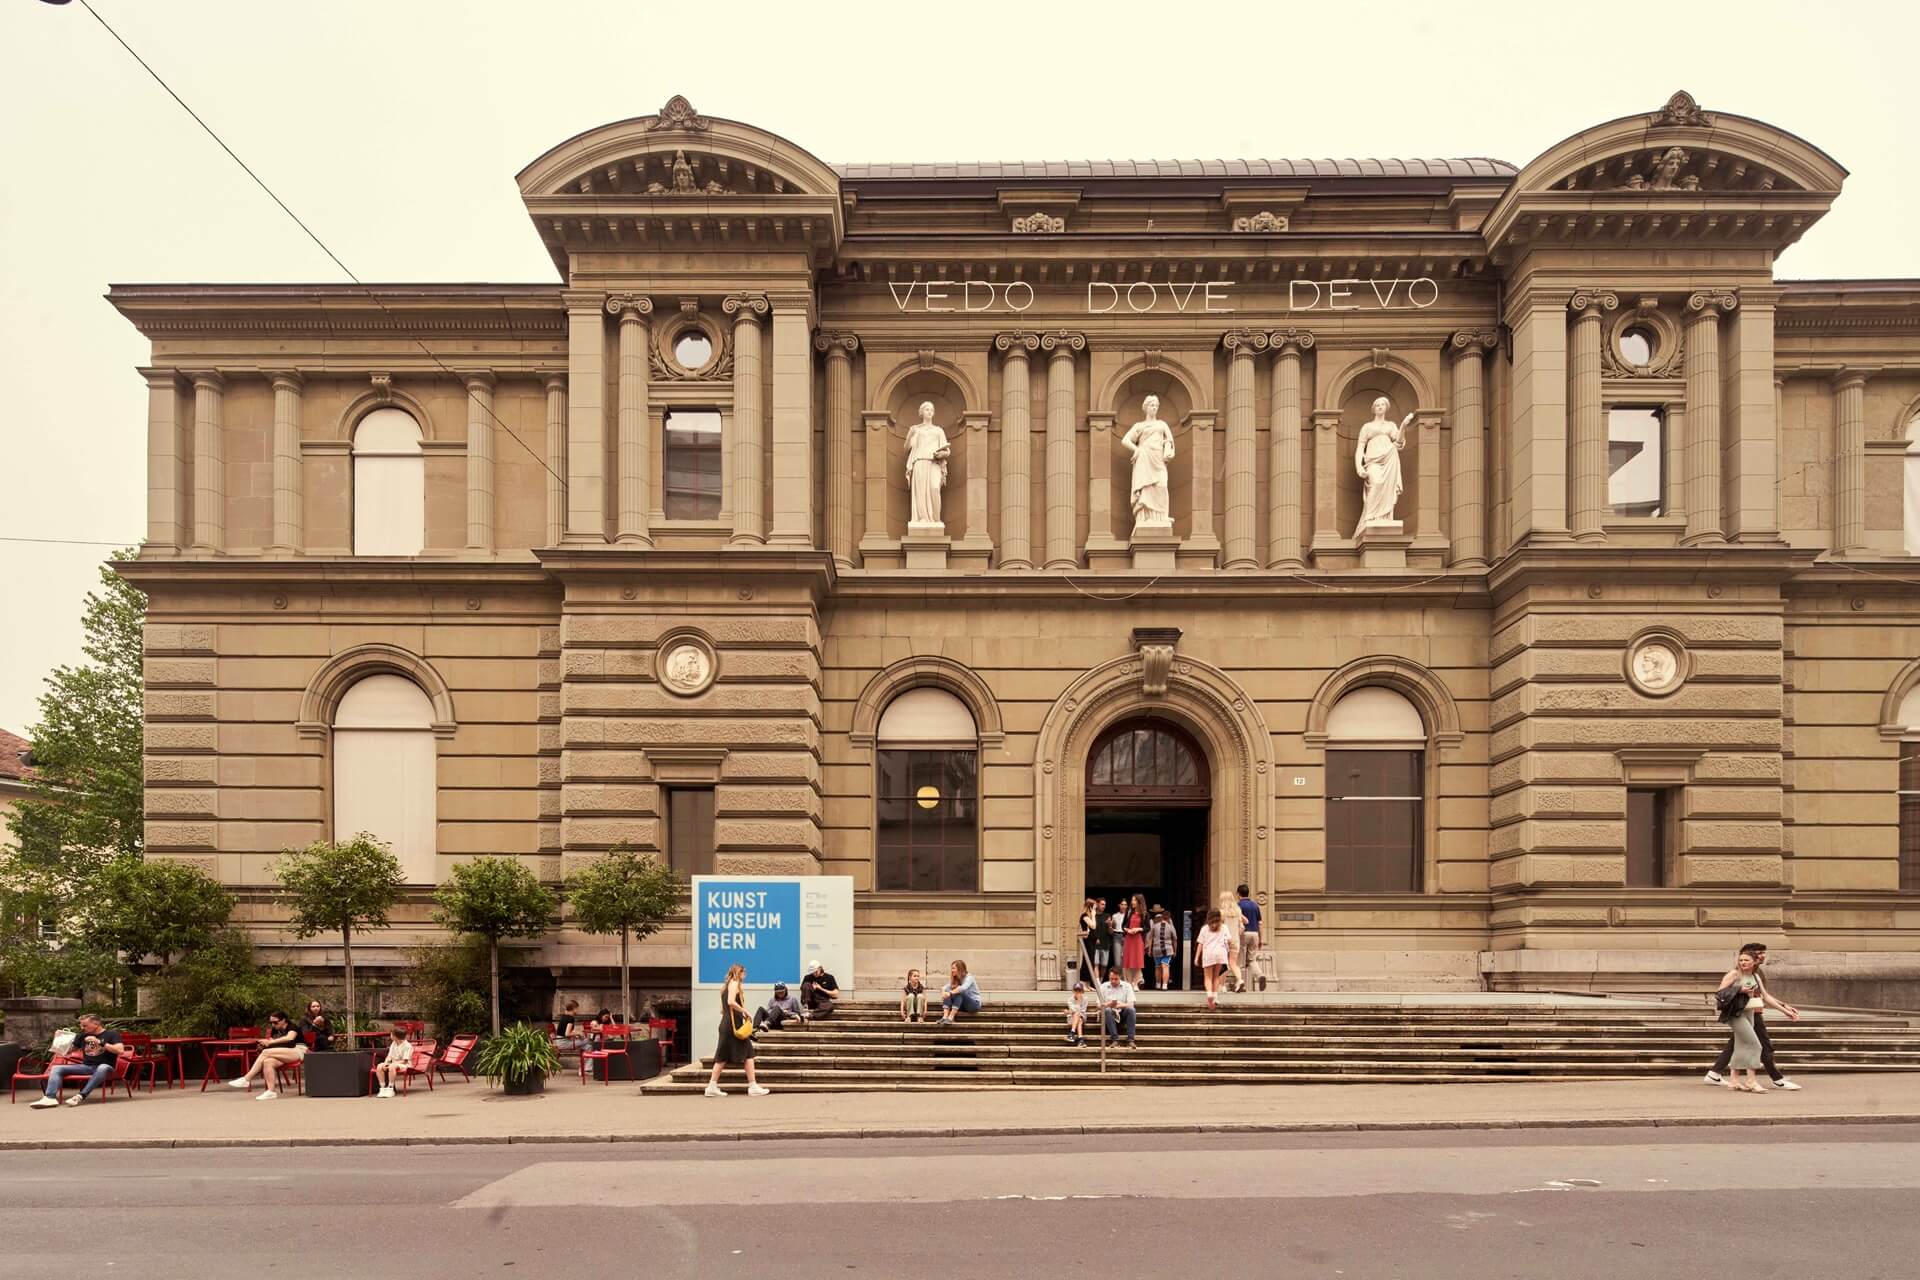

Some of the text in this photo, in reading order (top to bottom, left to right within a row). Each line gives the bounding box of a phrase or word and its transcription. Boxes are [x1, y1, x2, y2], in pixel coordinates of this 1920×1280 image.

[888, 277, 1438, 314] VEDO DOVE DEVO
[707, 891, 768, 909] KUNST
[707, 912, 782, 929] MUSEUM
[707, 932, 757, 950] BERN
